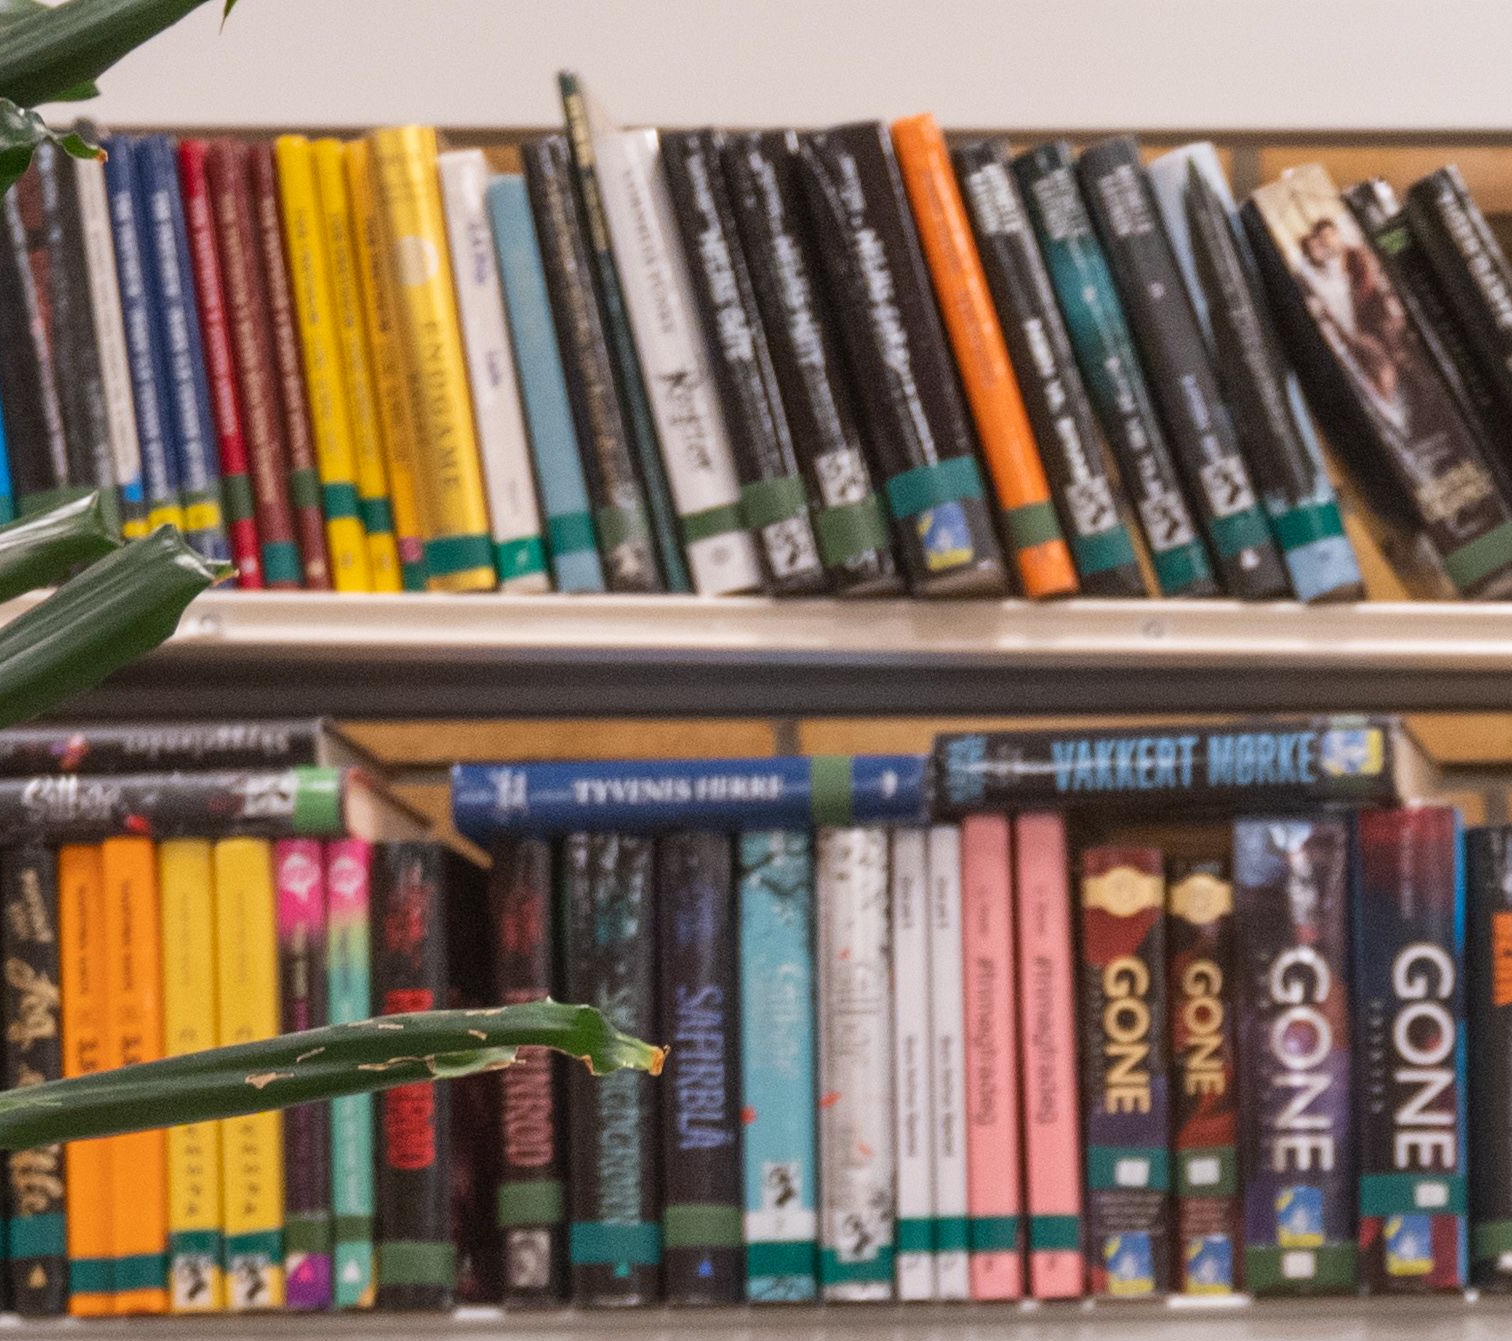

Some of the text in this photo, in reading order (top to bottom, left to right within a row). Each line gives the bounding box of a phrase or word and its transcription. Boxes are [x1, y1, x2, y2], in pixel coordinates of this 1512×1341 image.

[1431, 189, 1482, 260] TIGER
[412, 319, 468, 491] ENDGAME
[1051, 736, 1199, 792] VAKKERT
[676, 983, 734, 1151] SAFIRBLÅ
[1103, 957, 1153, 1115] GONE
[1183, 958, 1226, 1096] GONE
[1269, 946, 1334, 1173] GONE
[1391, 941, 1456, 1170] GONE
